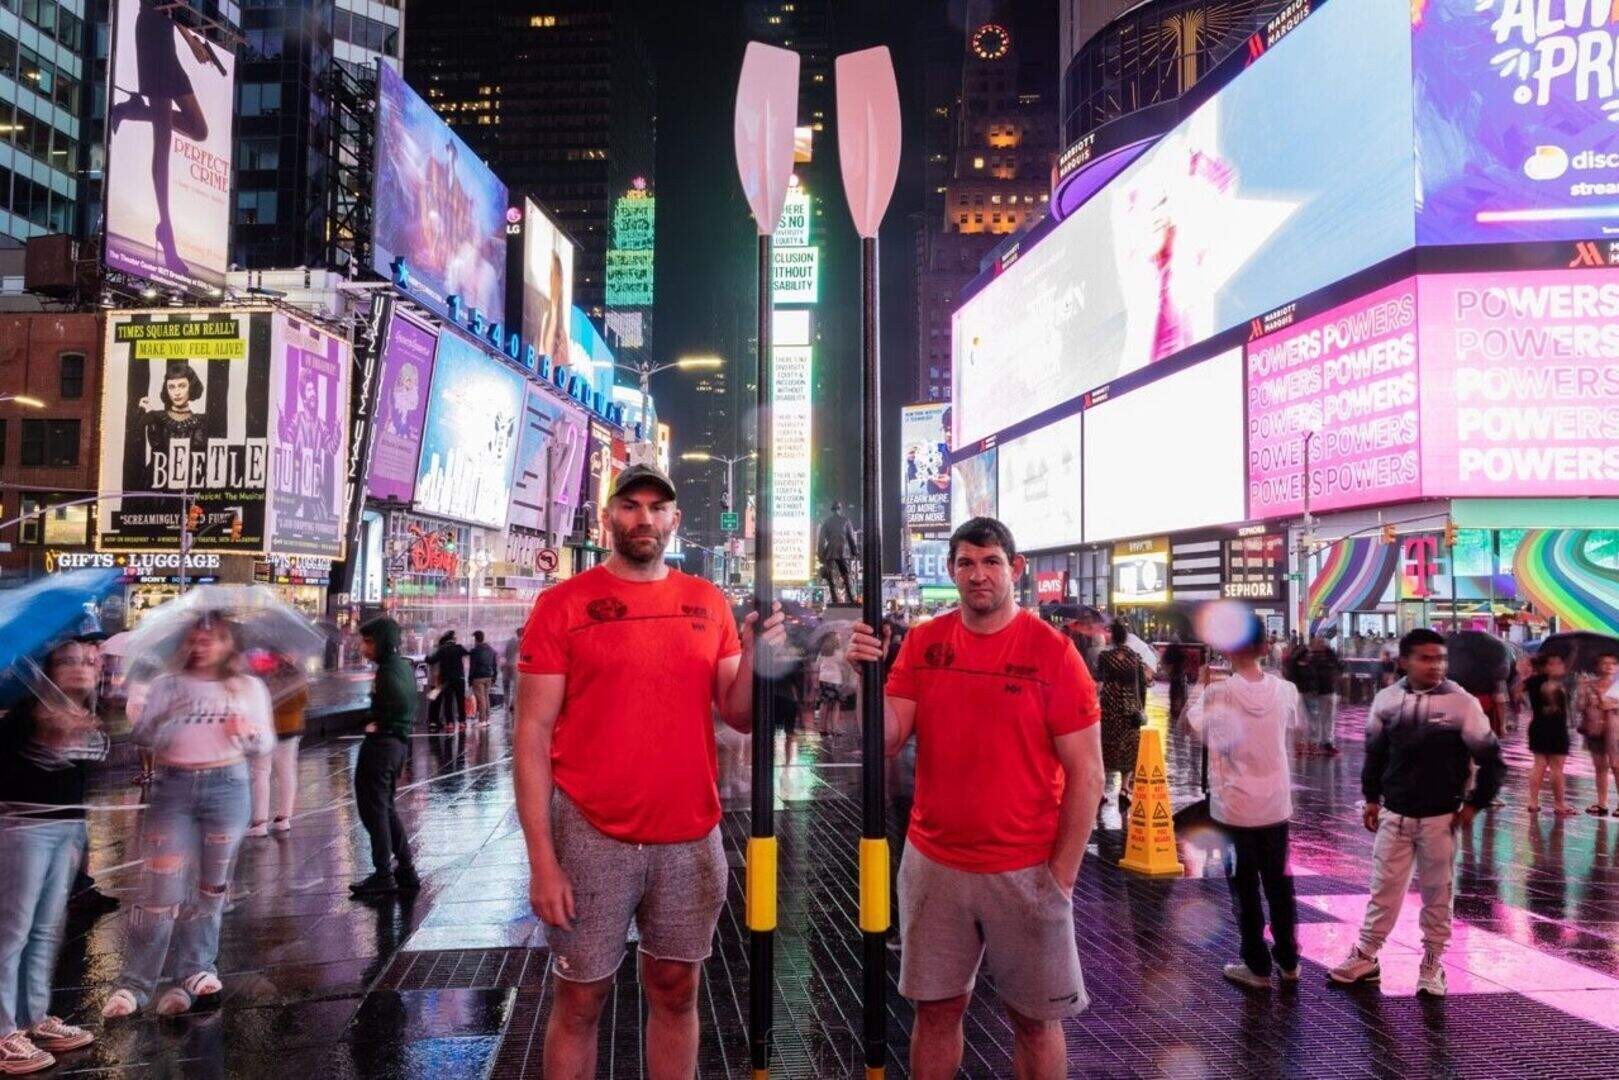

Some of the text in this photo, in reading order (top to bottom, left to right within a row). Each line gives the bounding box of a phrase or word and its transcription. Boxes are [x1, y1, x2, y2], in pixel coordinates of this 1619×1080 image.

[1267, 0, 1304, 34] MARRIO
[1267, 4, 1311, 48] MARQUIS
[1491, 0, 1613, 44] ALW
[1533, 29, 1619, 107] PR
[174, 138, 230, 176] PERFECT
[190, 163, 228, 193] CRIME
[1569, 182, 1619, 197] strea
[785, 204, 804, 214] ERE
[788, 216, 805, 228] NO
[506, 224, 521, 234] LG
[774, 252, 814, 263] CLUSION
[774, 266, 812, 278] ITHOUT
[773, 280, 813, 291] SABILITY
[1456, 283, 1619, 320] POWERS
[118, 321, 237, 339] TIMES SQUARE CAN REALLY
[1248, 292, 1415, 382] POWERS POWERS
[1455, 324, 1619, 361] POWERS
[138, 342, 166, 356] MAKE
[168, 342, 186, 355] YOU
[189, 342, 211, 355] FEEL
[1249, 332, 1416, 411] POWERS POWERS
[1454, 366, 1619, 402] POWERS
[1250, 371, 1417, 442] POWERS POWERS
[1457, 405, 1619, 441] POWERS
[1326, 410, 1417, 461] POWERS
[152, 444, 264, 489] BEETLE
[1327, 450, 1417, 494] POWERS
[1458, 446, 1619, 482] POWERS
[1238, 525, 1266, 537] SEPHORA
[58, 554, 220, 568] GIFTS LUGGAGE
[1405, 536, 1438, 596] T
[1225, 582, 1273, 598] SEPHORA
